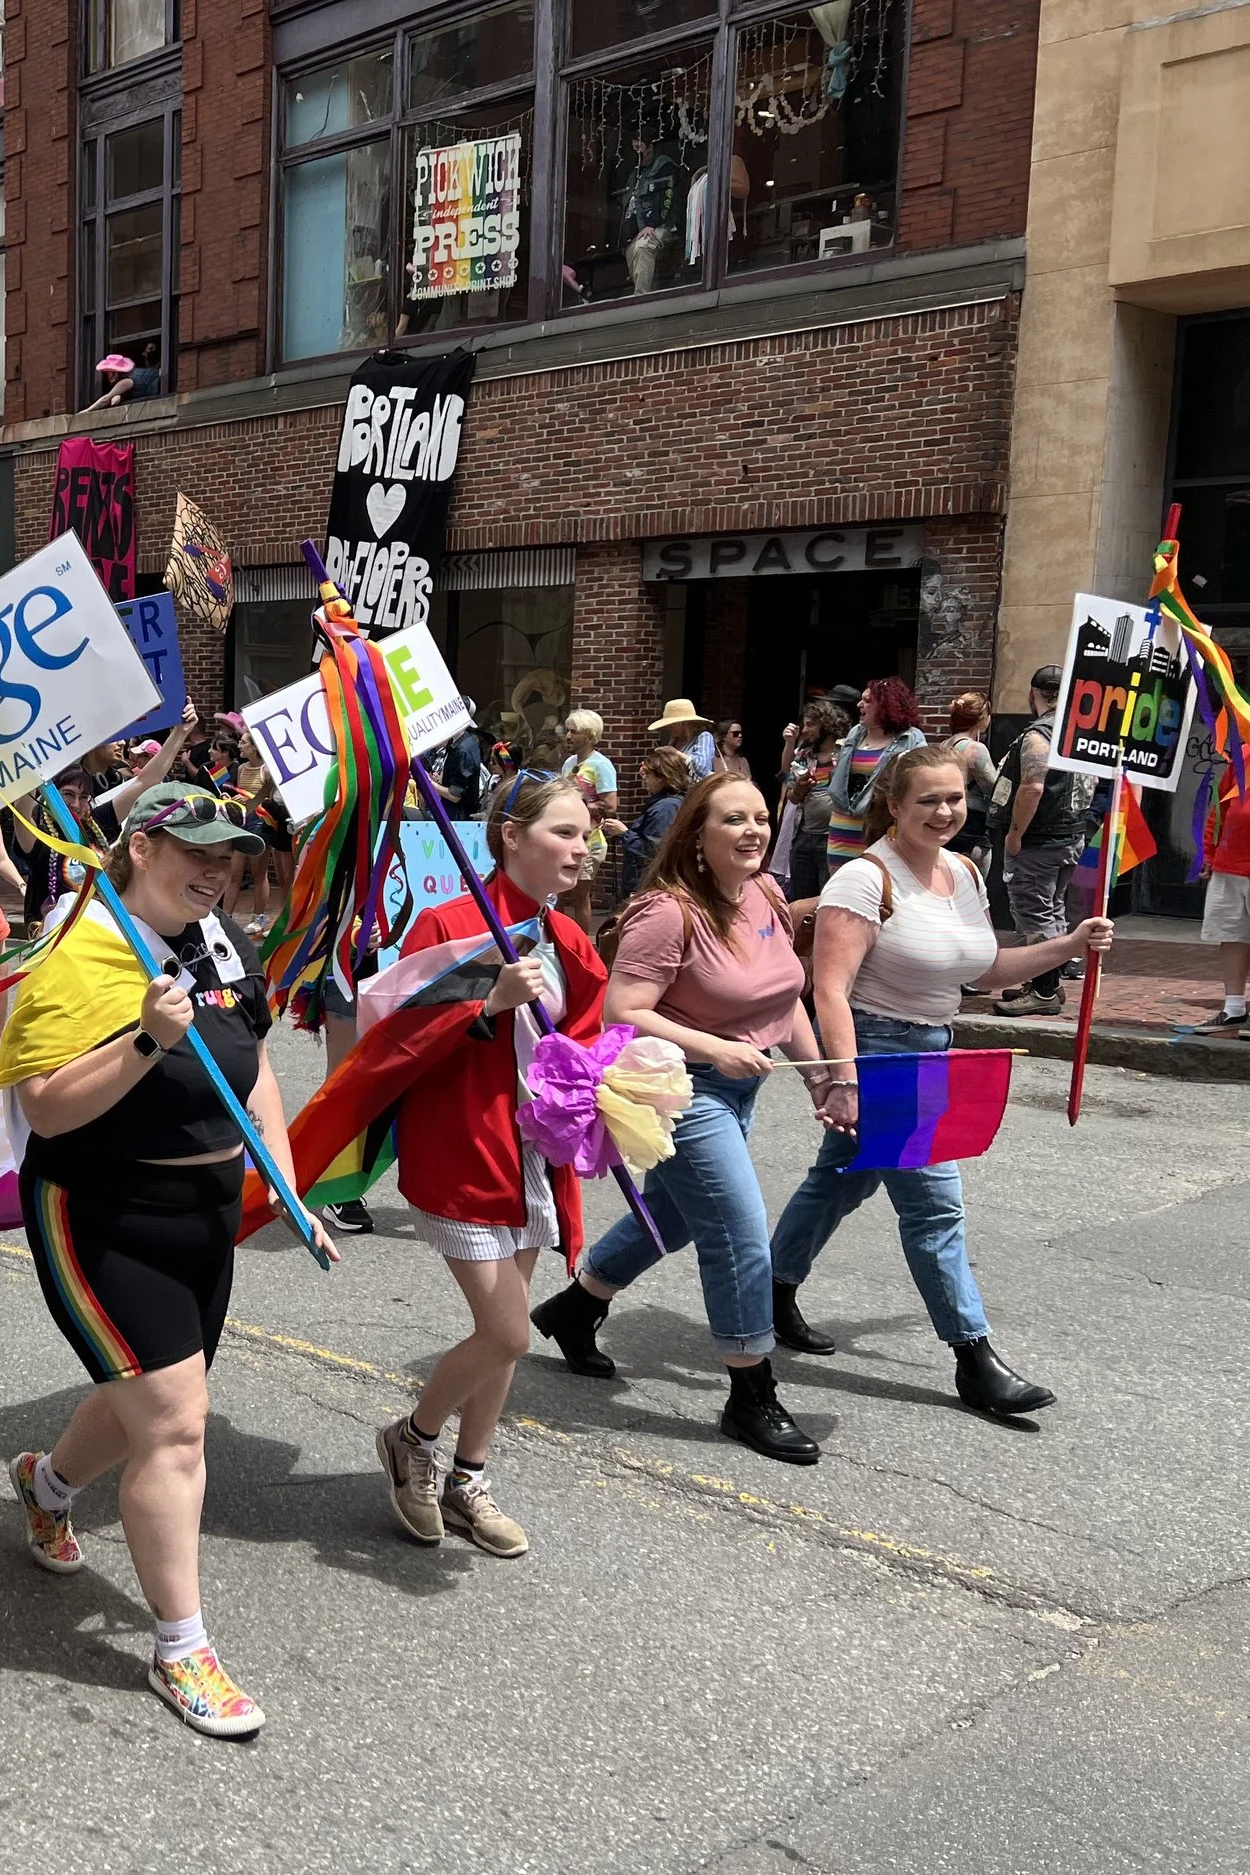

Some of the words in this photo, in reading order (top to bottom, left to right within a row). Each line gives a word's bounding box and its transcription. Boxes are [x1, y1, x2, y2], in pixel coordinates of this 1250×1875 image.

[413, 136, 522, 207] PICKWICK
[432, 196, 500, 220] independent
[412, 211, 521, 266] PRESS
[465, 277, 492, 294] PRINT
[337, 384, 465, 482] PORTLAND
[55, 560, 72, 577] SM
[656, 529, 904, 578] SPACE
[407, 696, 465, 742] UALITYMAINE
[1062, 672, 1182, 758] pride
[1076, 737, 1158, 768] PORTLAND
